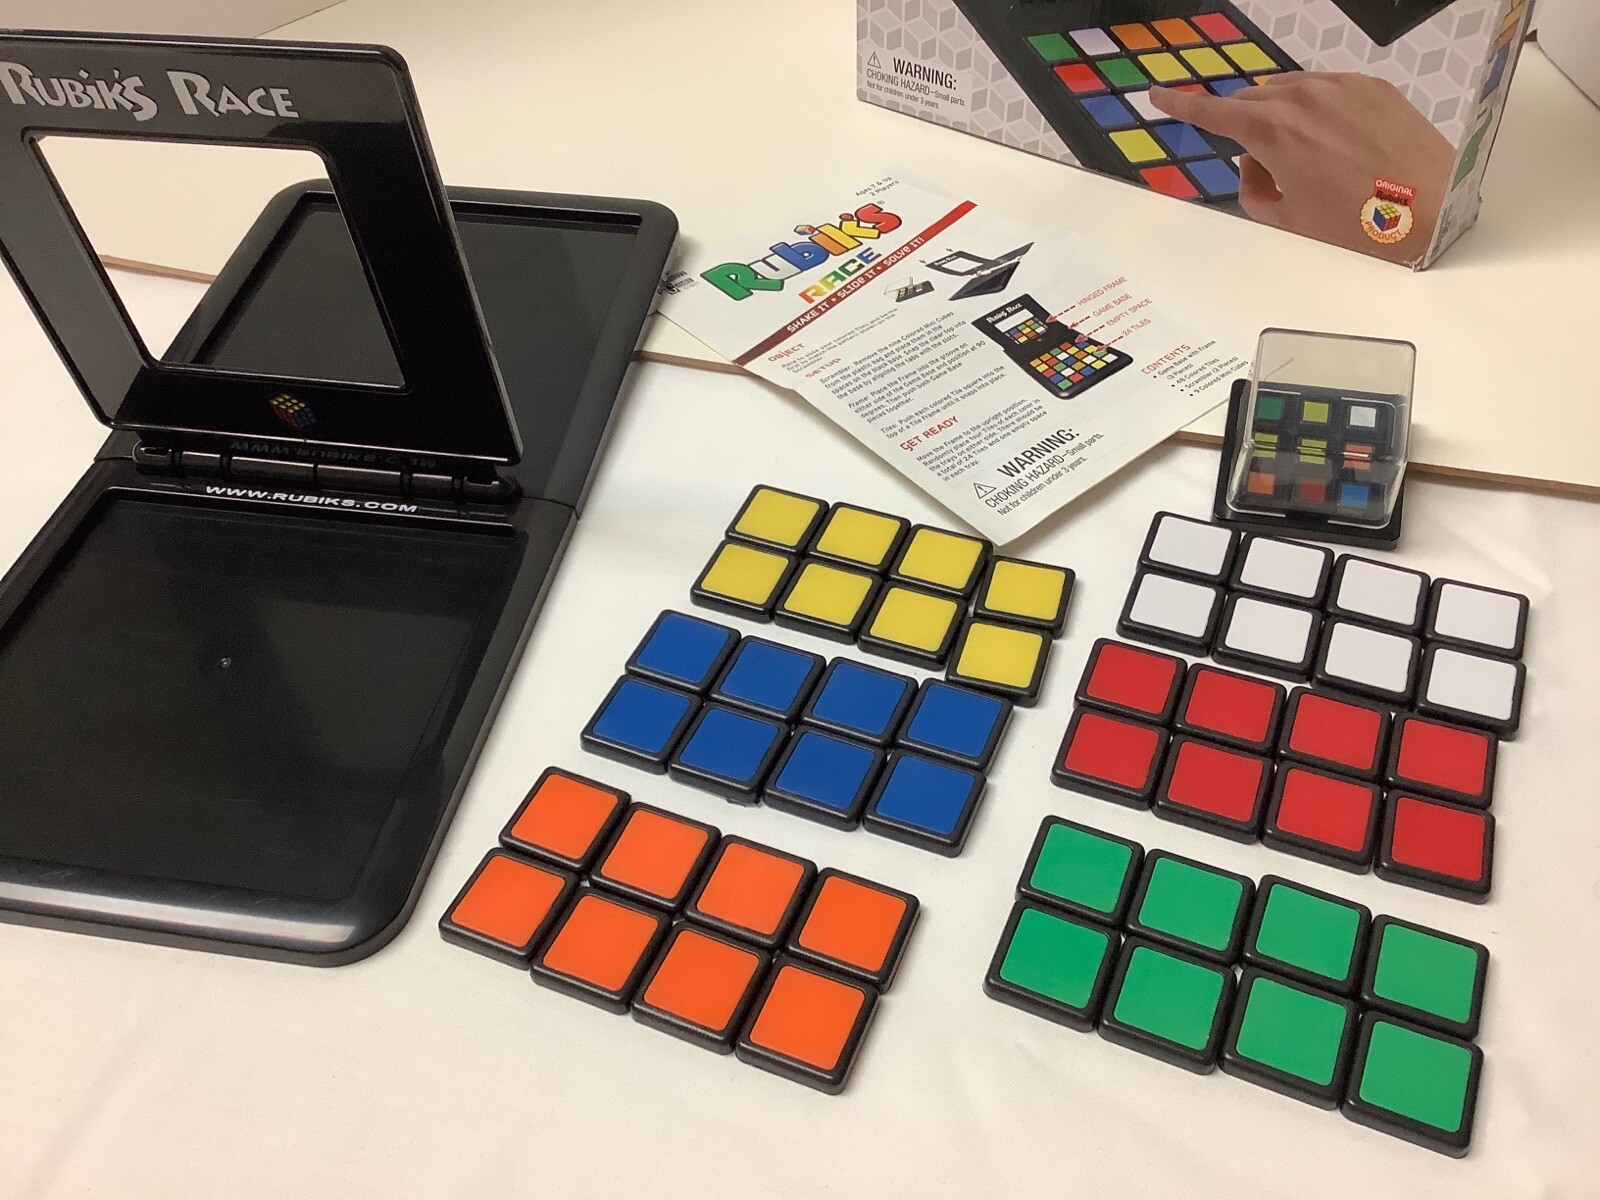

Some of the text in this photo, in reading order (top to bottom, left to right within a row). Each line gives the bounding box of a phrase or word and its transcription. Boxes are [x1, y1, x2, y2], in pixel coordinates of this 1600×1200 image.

[867, 68, 898, 86] CHOKING
[950, 97, 966, 106] parts.
[893, 58, 957, 90] WARNING:
[867, 80, 876, 89] Not
[884, 85, 904, 98] children
[904, 91, 919, 102] under
[925, 99, 940, 109] years.
[1376, 180, 1414, 196] ORIGINAL
[1365, 222, 1402, 240] PRODUCT
[787, 310, 820, 332] SHAKE
[818, 302, 830, 312] IT
[864, 269, 877, 280] IT
[910, 236, 925, 250] IT!
[798, 246, 883, 304] RACE
[1076, 276, 1128, 306] HINGED FRAME
[1092, 293, 1132, 316] GAME BASE
[1106, 298, 1152, 326] EMPTY SPACE
[1130, 318, 1152, 330] TILES
[1140, 344, 1191, 374] CONTENTS
[848, 348, 960, 409] Frame: Place the Frame into groove
[855, 402, 873, 414] either
[873, 396, 886, 404] side
[903, 377, 921, 387] Game
[920, 369, 936, 378] Base
[936, 362, 948, 370] and
[885, 395, 903, 404] Then
[902, 387, 917, 398] push
[916, 380, 931, 389] both
[930, 371, 948, 381] Game
[947, 363, 962, 372] Base
[867, 412, 887, 424] pieces
[880, 424, 896, 433] Tiles:
[898, 415, 915, 425] Push
[915, 407, 930, 416] each
[929, 394, 952, 408] colored
[963, 378, 983, 390] square
[922, 416, 958, 439] READY
[996, 428, 1080, 478] WARNING:
[984, 478, 1029, 508] CHOKING
[1084, 432, 1104, 446] parts.
[205, 486, 418, 513] WWW.RUBIKS.COM
[996, 504, 1012, 516] Not
[1009, 499, 1022, 508] for
[1020, 482, 1046, 502] children
[1045, 470, 1064, 485] under
[1068, 456, 1088, 471] years.
